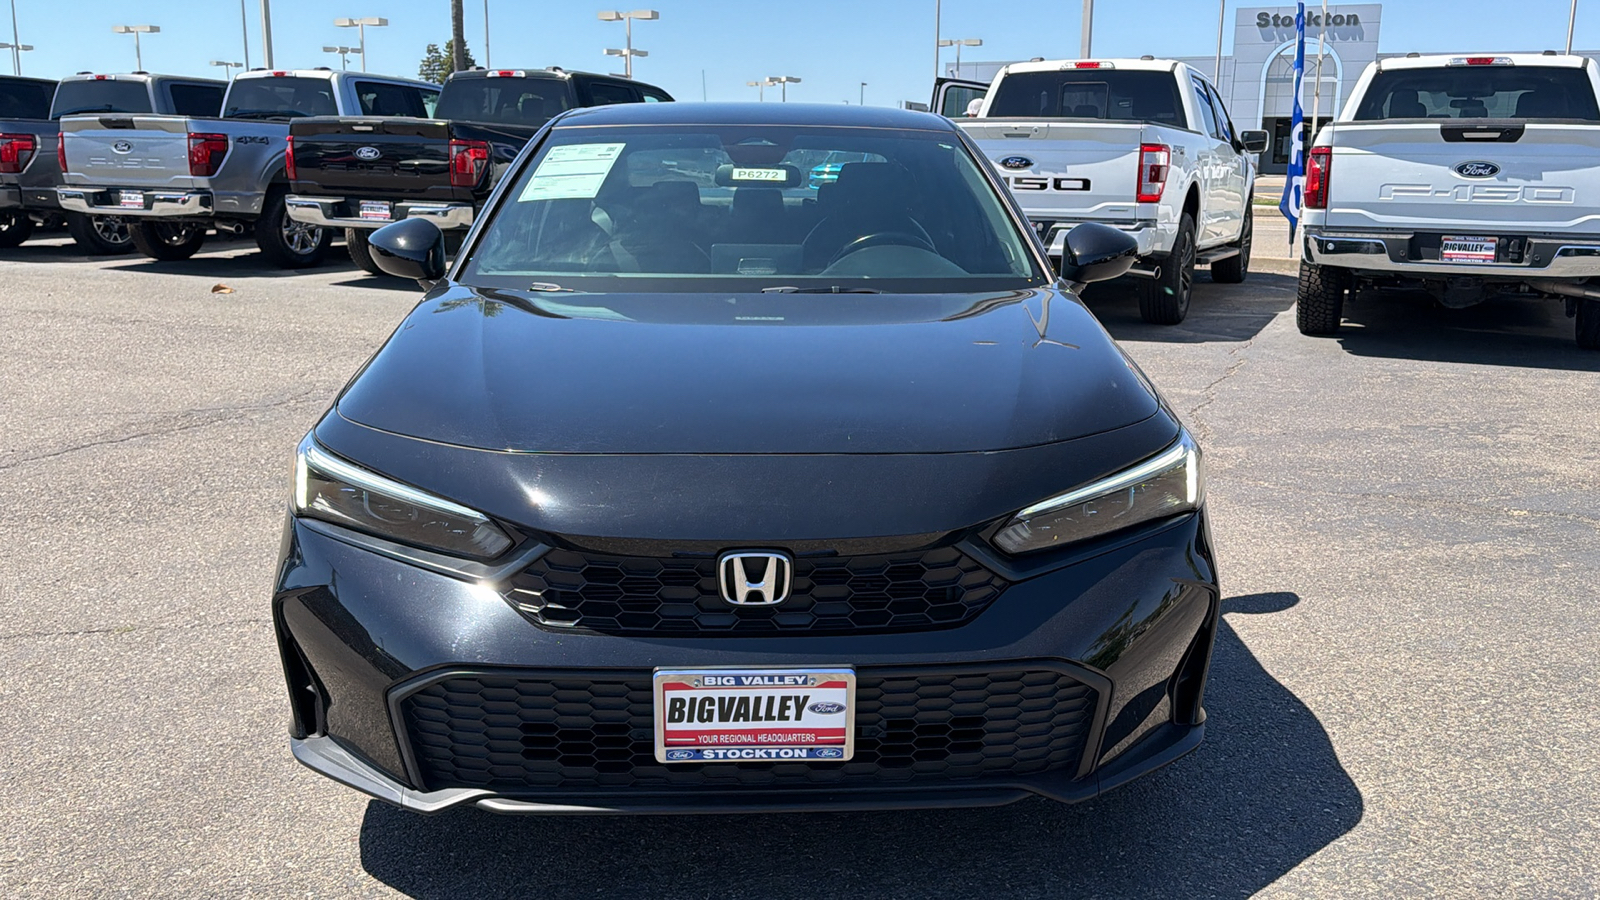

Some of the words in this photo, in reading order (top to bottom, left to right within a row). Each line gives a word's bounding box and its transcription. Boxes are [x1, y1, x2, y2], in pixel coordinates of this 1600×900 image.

[1256, 11, 1360, 28] Stokton
[738, 170, 779, 179] P6272
[1461, 163, 1493, 176] Ford
[1379, 183, 1576, 204] F-150
[1443, 242, 1485, 252] BIGVALLEY
[703, 676, 736, 686] BIG
[740, 675, 807, 686] VALLEY
[667, 695, 811, 724] BIGVALLEY
[814, 702, 839, 713] Ford
[697, 734, 719, 744] YOUR
[719, 734, 756, 743] REGIONAL
[757, 733, 816, 743] HEADQUARTERS
[702, 748, 808, 759] STOCKTON
